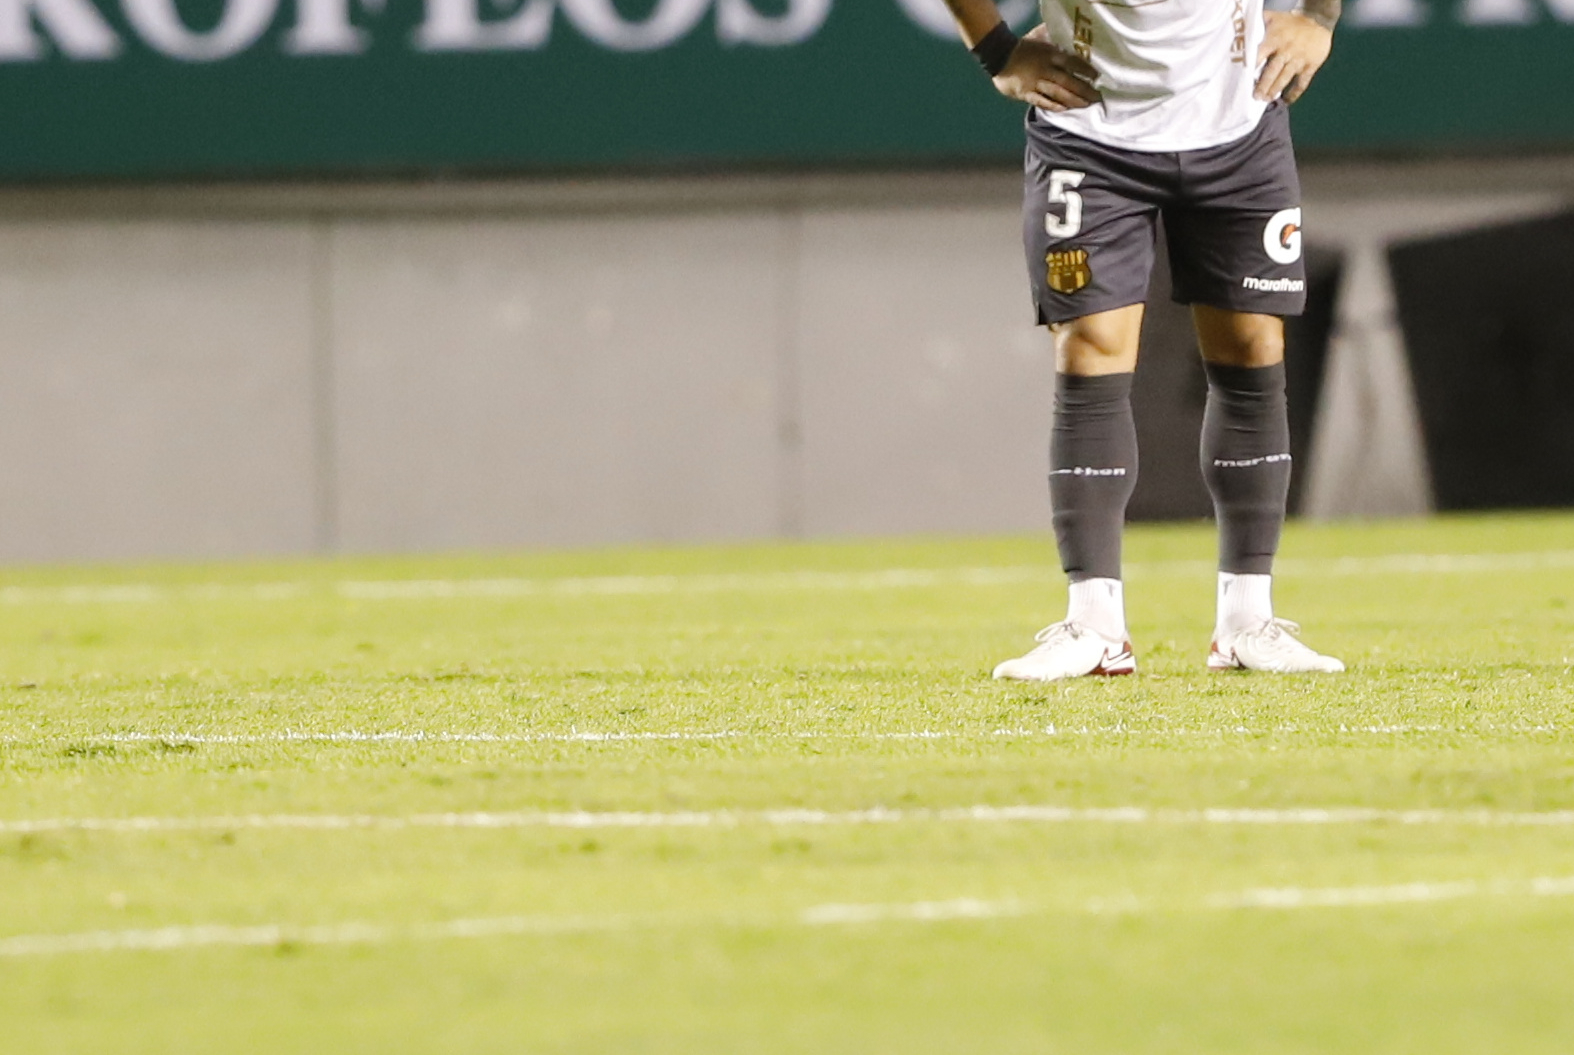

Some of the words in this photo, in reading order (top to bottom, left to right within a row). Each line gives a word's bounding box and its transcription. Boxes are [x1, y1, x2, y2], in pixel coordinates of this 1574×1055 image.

[1045, 169, 1086, 238] 5
[1263, 207, 1302, 265] G
[1243, 276, 1304, 292] marathon
